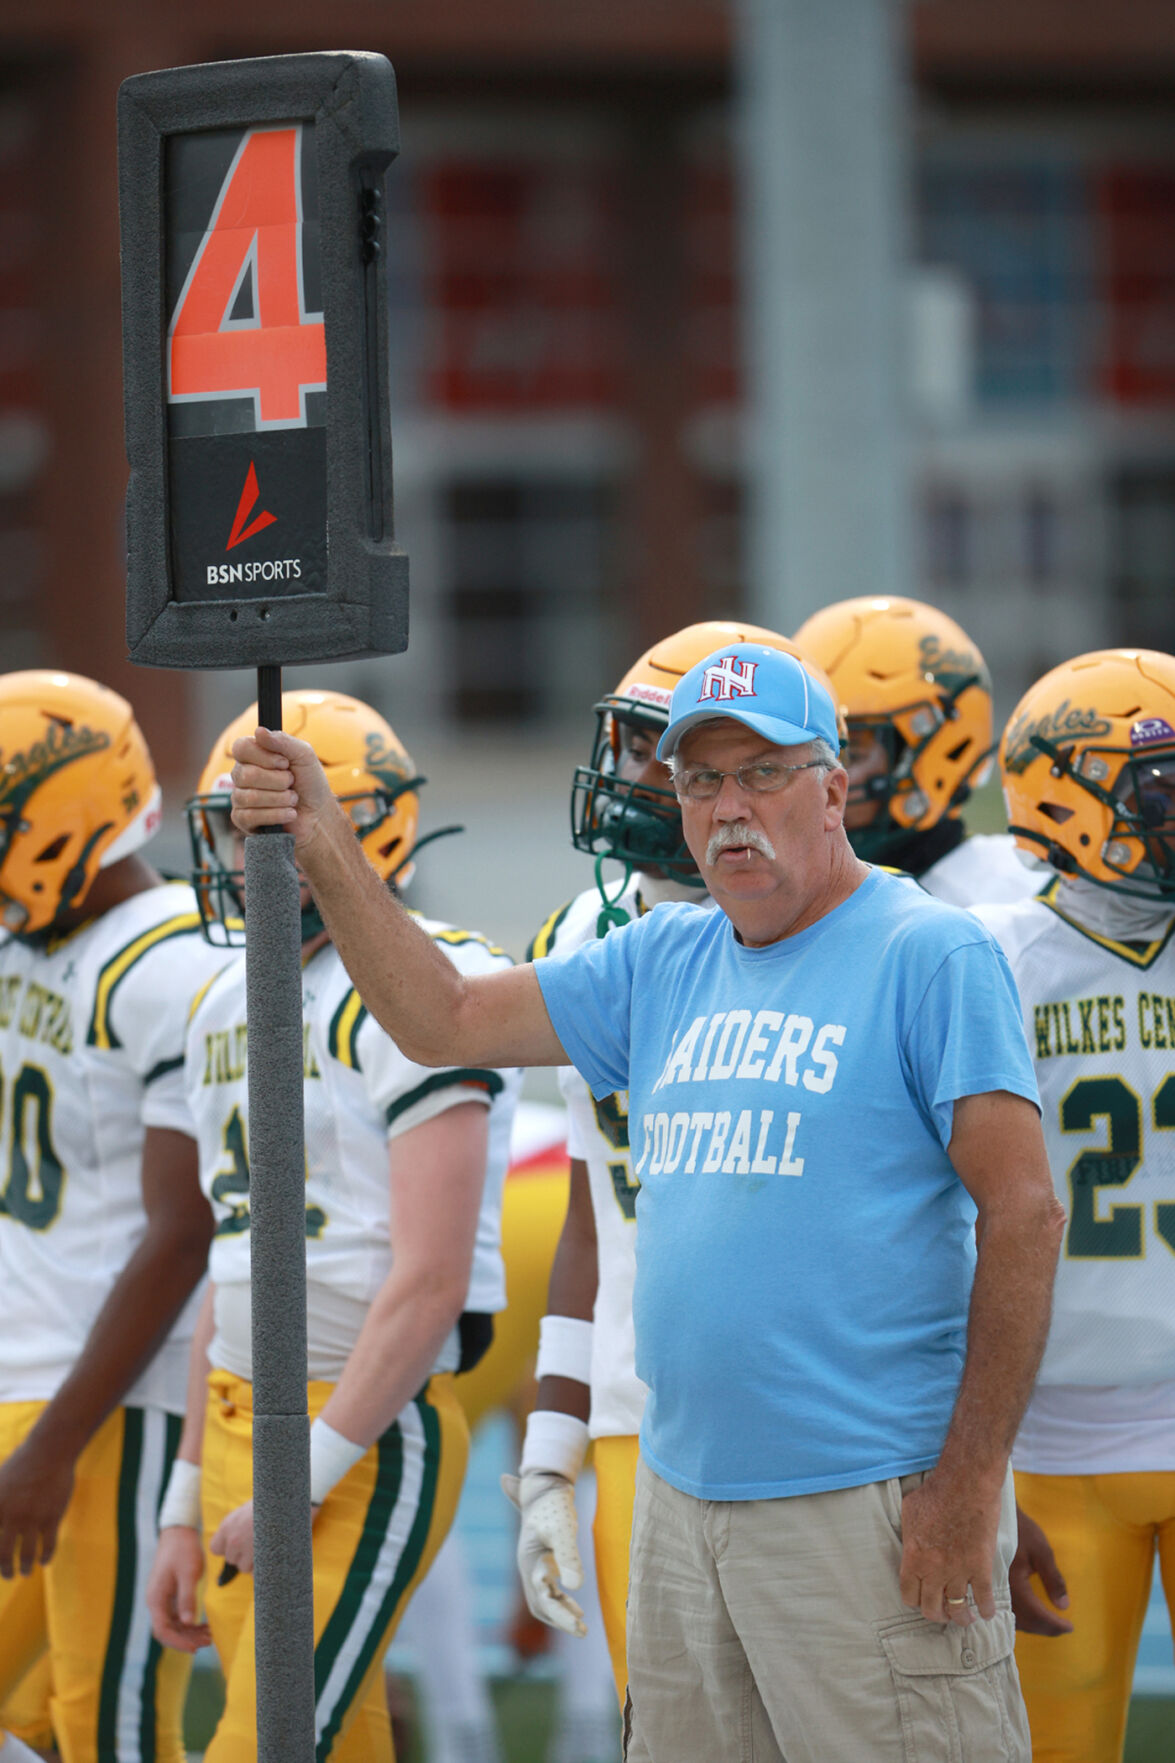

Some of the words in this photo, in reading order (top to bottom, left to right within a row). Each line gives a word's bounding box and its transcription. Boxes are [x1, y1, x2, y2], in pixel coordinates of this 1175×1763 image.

[167, 124, 327, 432] 4
[652, 1009, 848, 1095] AIDERS
[1034, 994, 1126, 1059] WILKES
[0, 1052, 67, 1233] 0
[1058, 1071, 1175, 1262] 2
